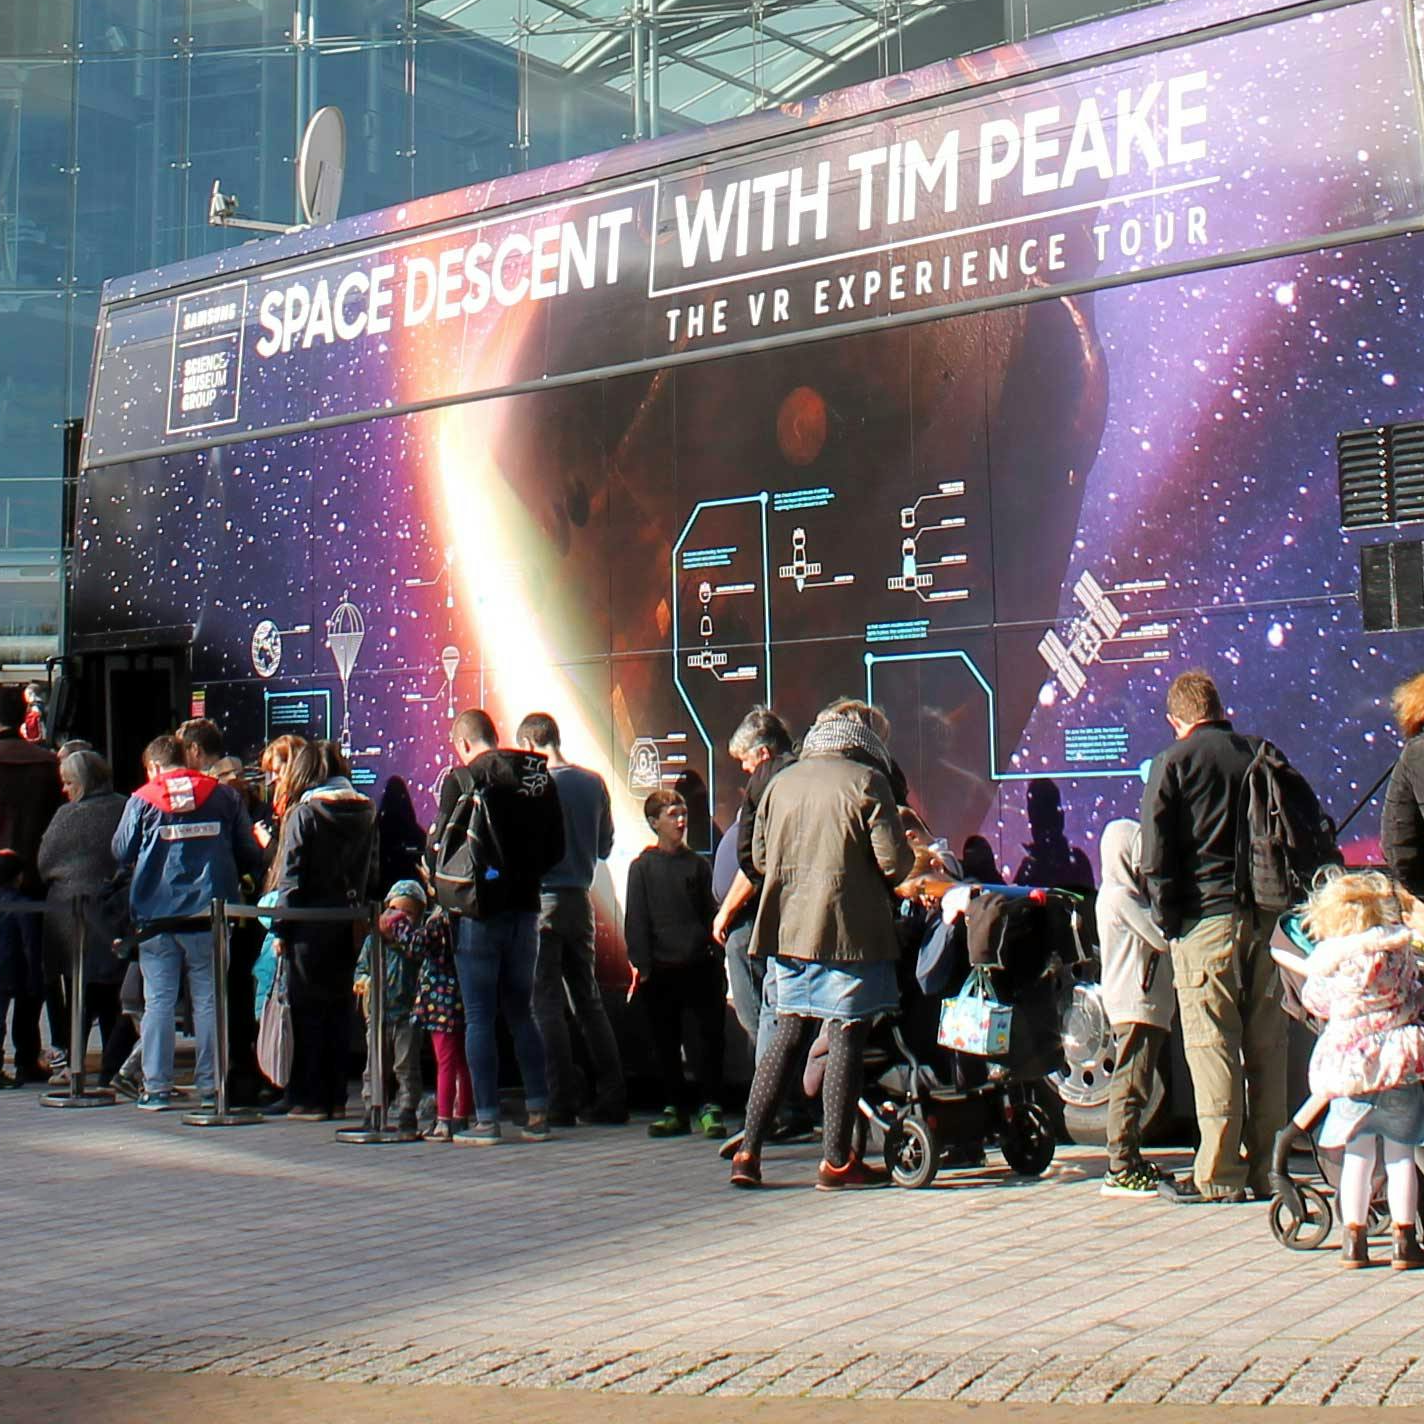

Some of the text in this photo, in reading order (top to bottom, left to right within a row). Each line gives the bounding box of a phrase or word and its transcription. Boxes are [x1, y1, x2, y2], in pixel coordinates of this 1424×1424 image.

[256, 70, 1208, 358] SPACE DESCENT WITH TIM PEAKE
[667, 205, 1208, 342] THE VR EXPERIENCE TOUR
[183, 303, 237, 331] SAMSUNG
[184, 352, 228, 377] SCIENCE
[183, 370, 227, 393] MUSEUM
[182, 389, 217, 411] GROUP
